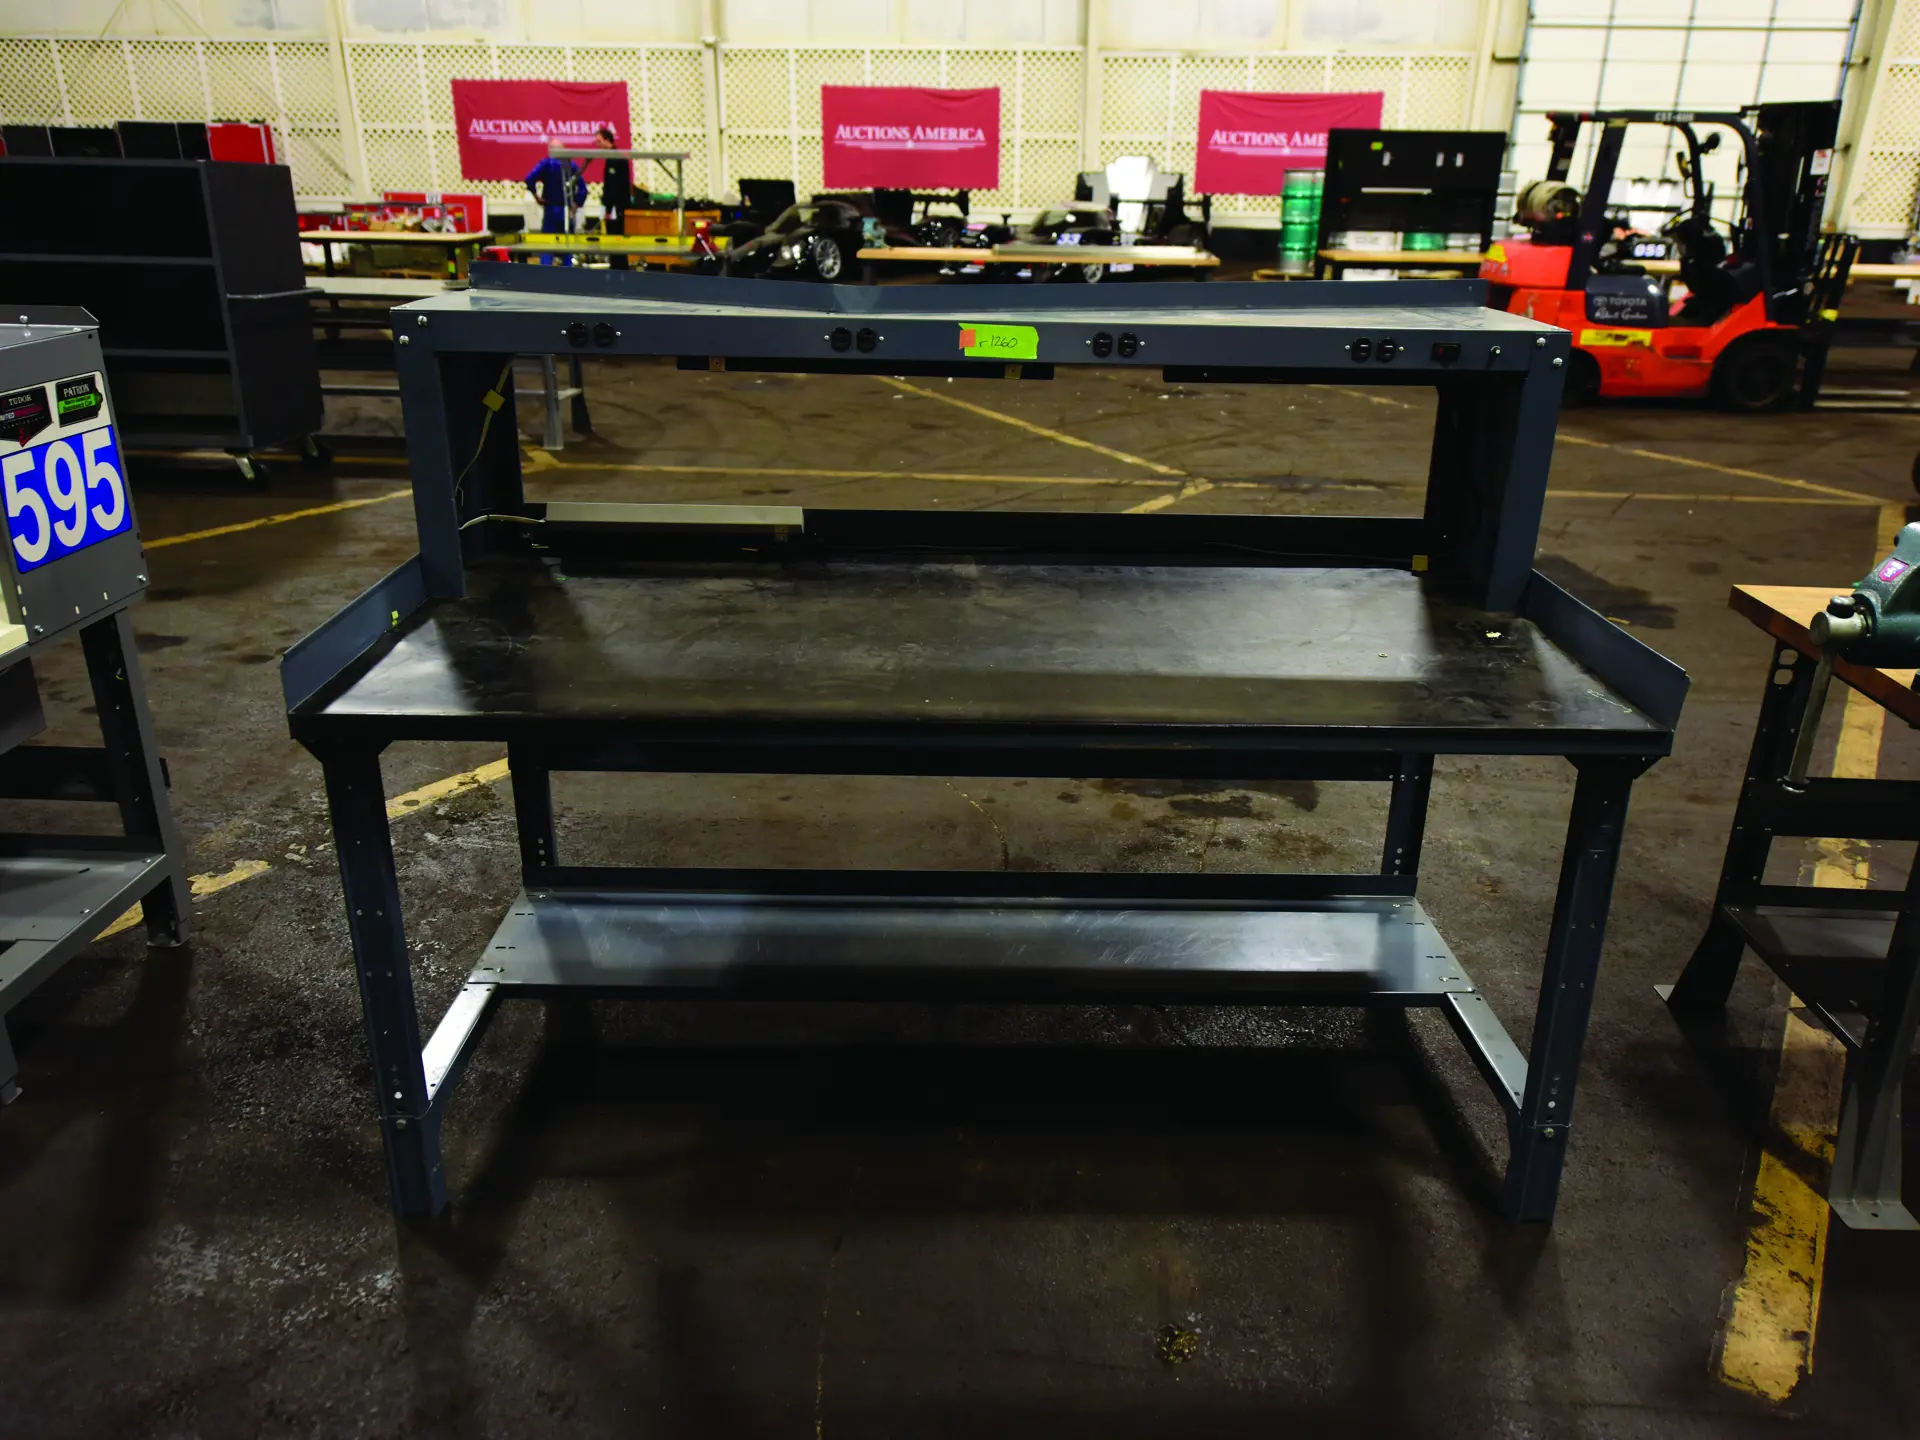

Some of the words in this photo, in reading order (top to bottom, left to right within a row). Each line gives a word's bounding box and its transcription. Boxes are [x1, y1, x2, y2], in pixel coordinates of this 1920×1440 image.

[469, 118, 543, 134] AUCTIONS
[835, 124, 911, 140] AUCTIONS
[913, 125, 985, 141] AMERICA
[1210, 129, 1288, 145] AUCTIONS
[1290, 130, 1328, 147] AME
[1609, 297, 1648, 306] TOYOTA
[8, 394, 32, 406] TUDOR
[2, 427, 125, 562] 595
